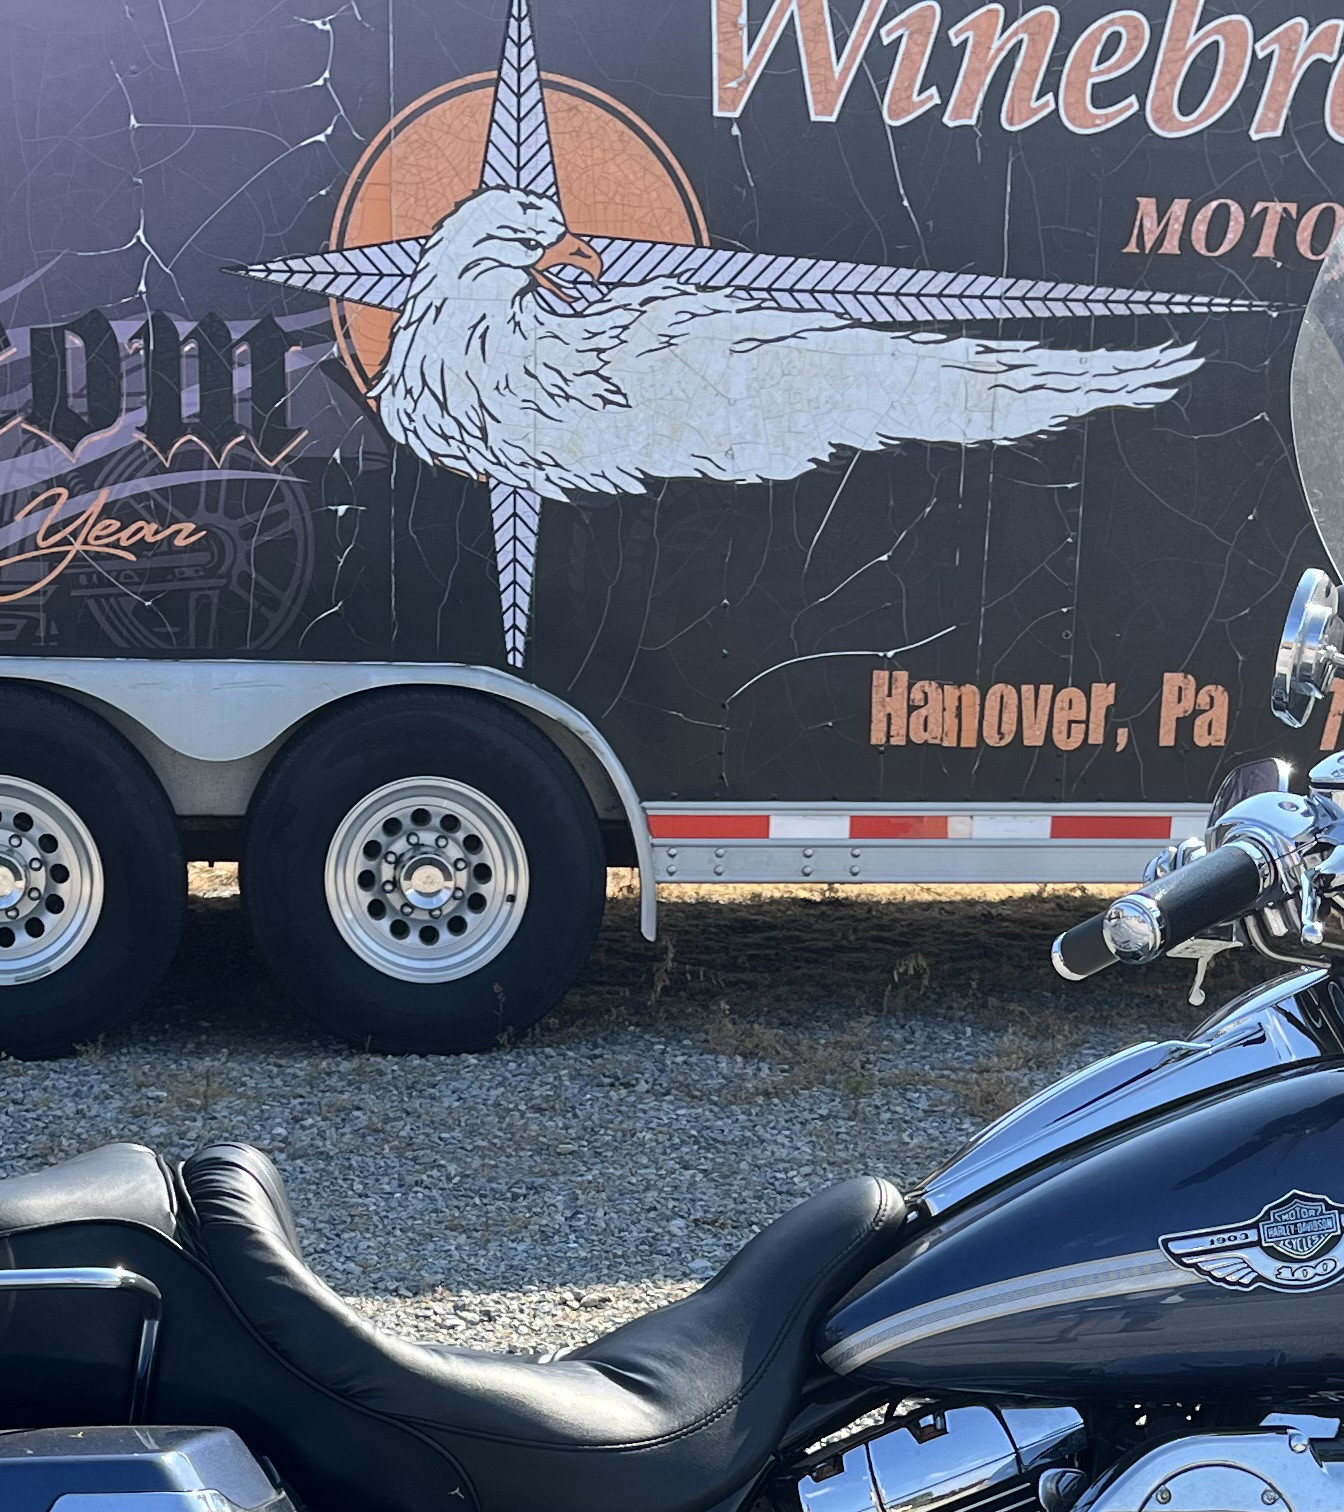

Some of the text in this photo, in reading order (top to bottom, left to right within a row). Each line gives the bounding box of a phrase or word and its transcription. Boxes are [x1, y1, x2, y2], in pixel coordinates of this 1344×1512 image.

[869, 669, 1130, 752] Hanover,
[1158, 671, 1230, 749] Pa
[1281, 1206, 1316, 1221] MOTOR
[1267, 1218, 1333, 1238] HARLEY-DAVIDSON
[1209, 1232, 1250, 1246] 1903
[1284, 1234, 1320, 1253] CYCLES
